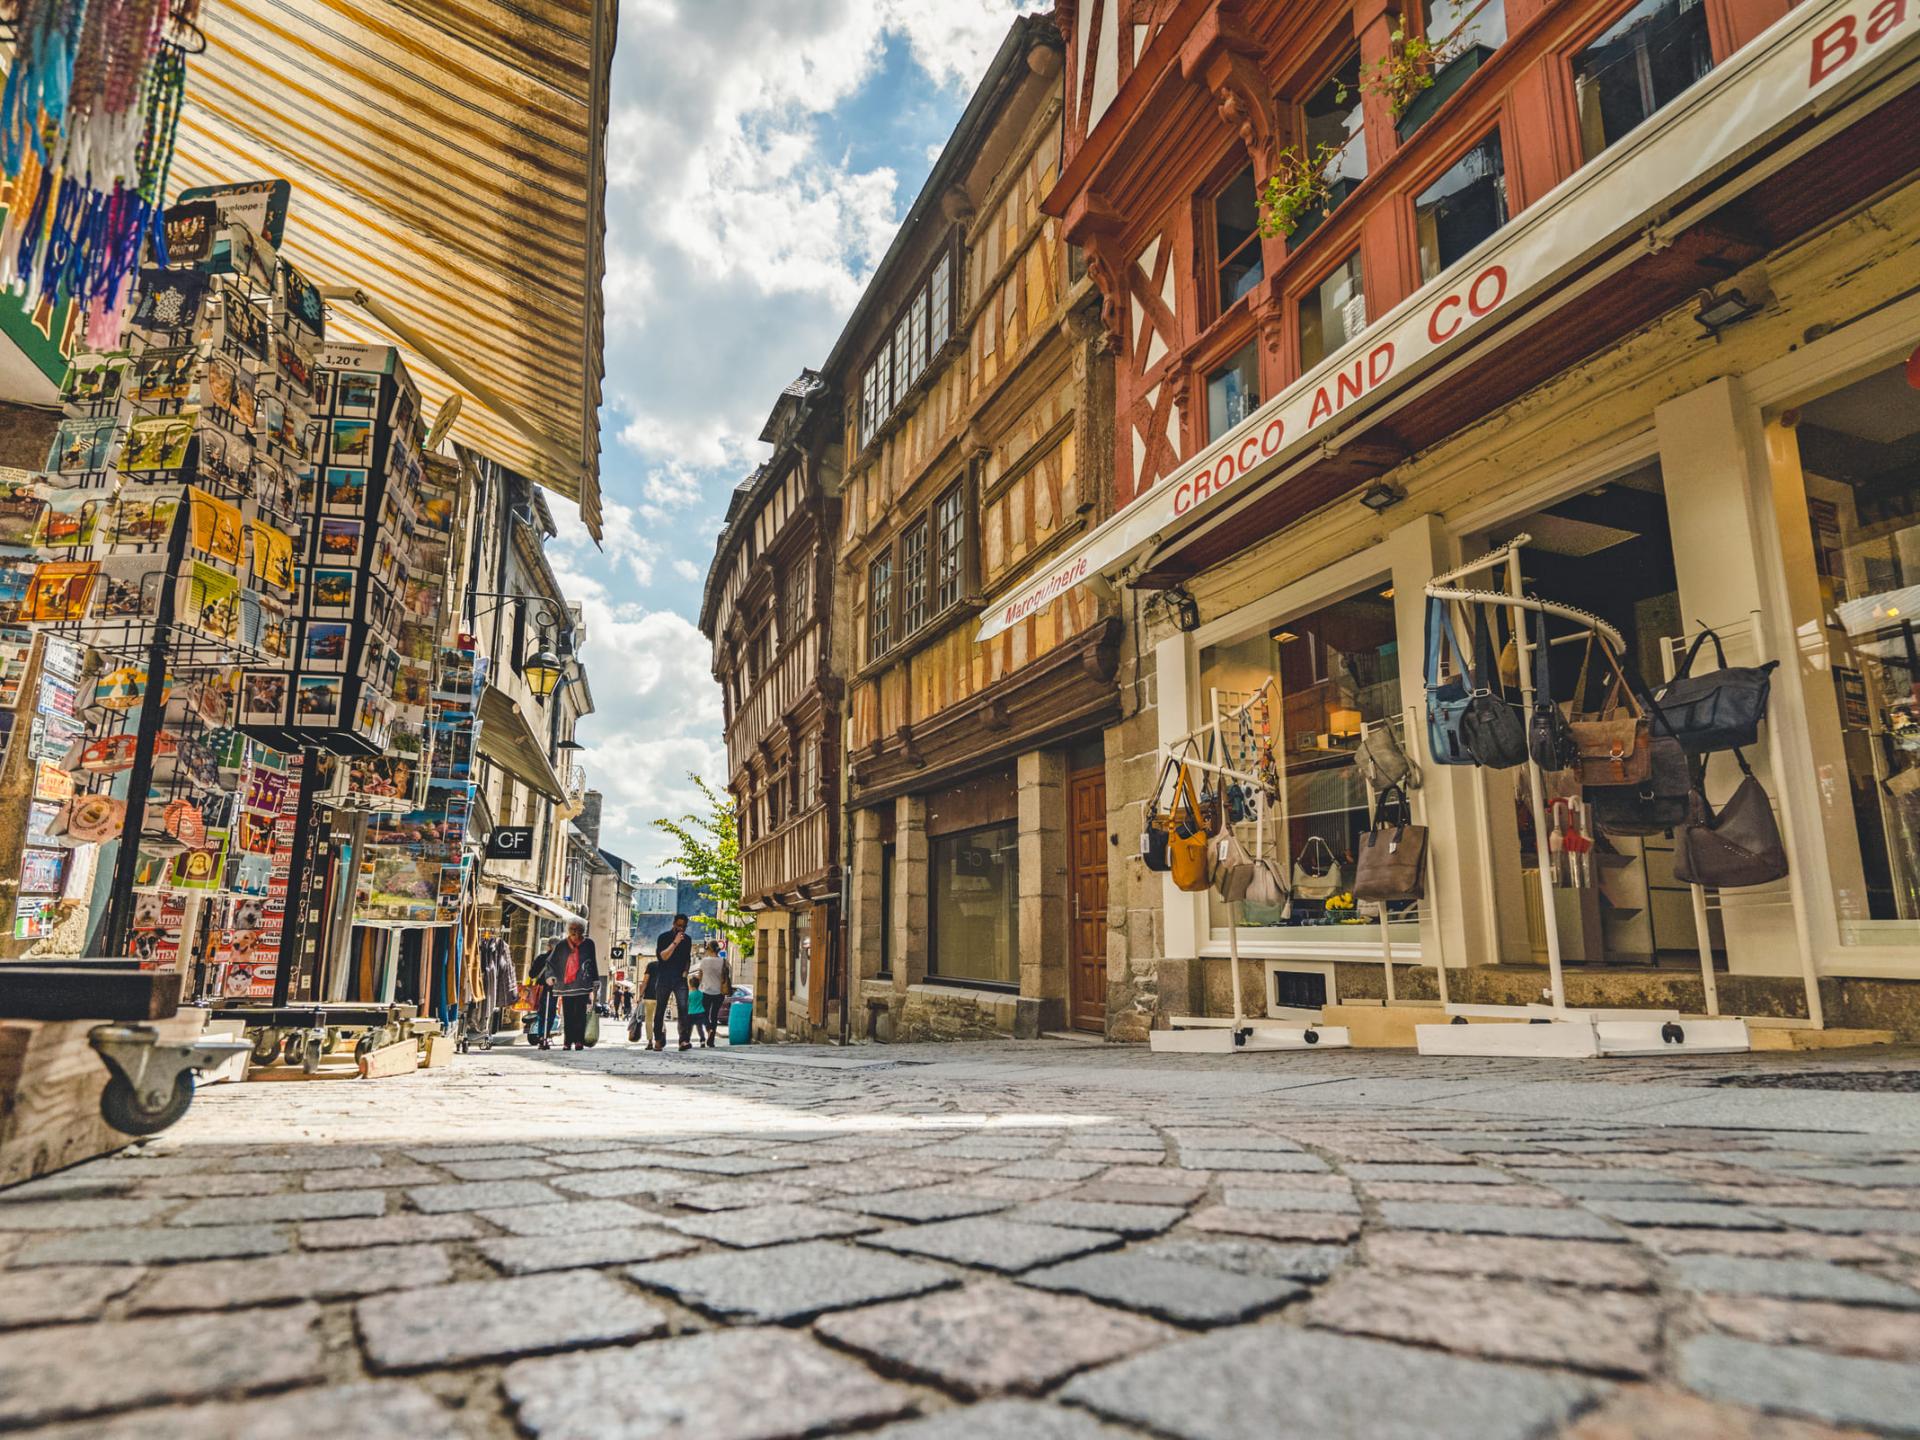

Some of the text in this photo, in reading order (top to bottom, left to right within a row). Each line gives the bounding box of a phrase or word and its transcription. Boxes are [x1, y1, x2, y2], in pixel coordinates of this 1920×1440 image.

[1808, 0, 1920, 89] Ba
[325, 355, 362, 366] 1,20 €
[1174, 265, 1508, 517] CROCO AND CO
[1005, 558, 1087, 624] Maroquinerie
[498, 831, 528, 848] CF
